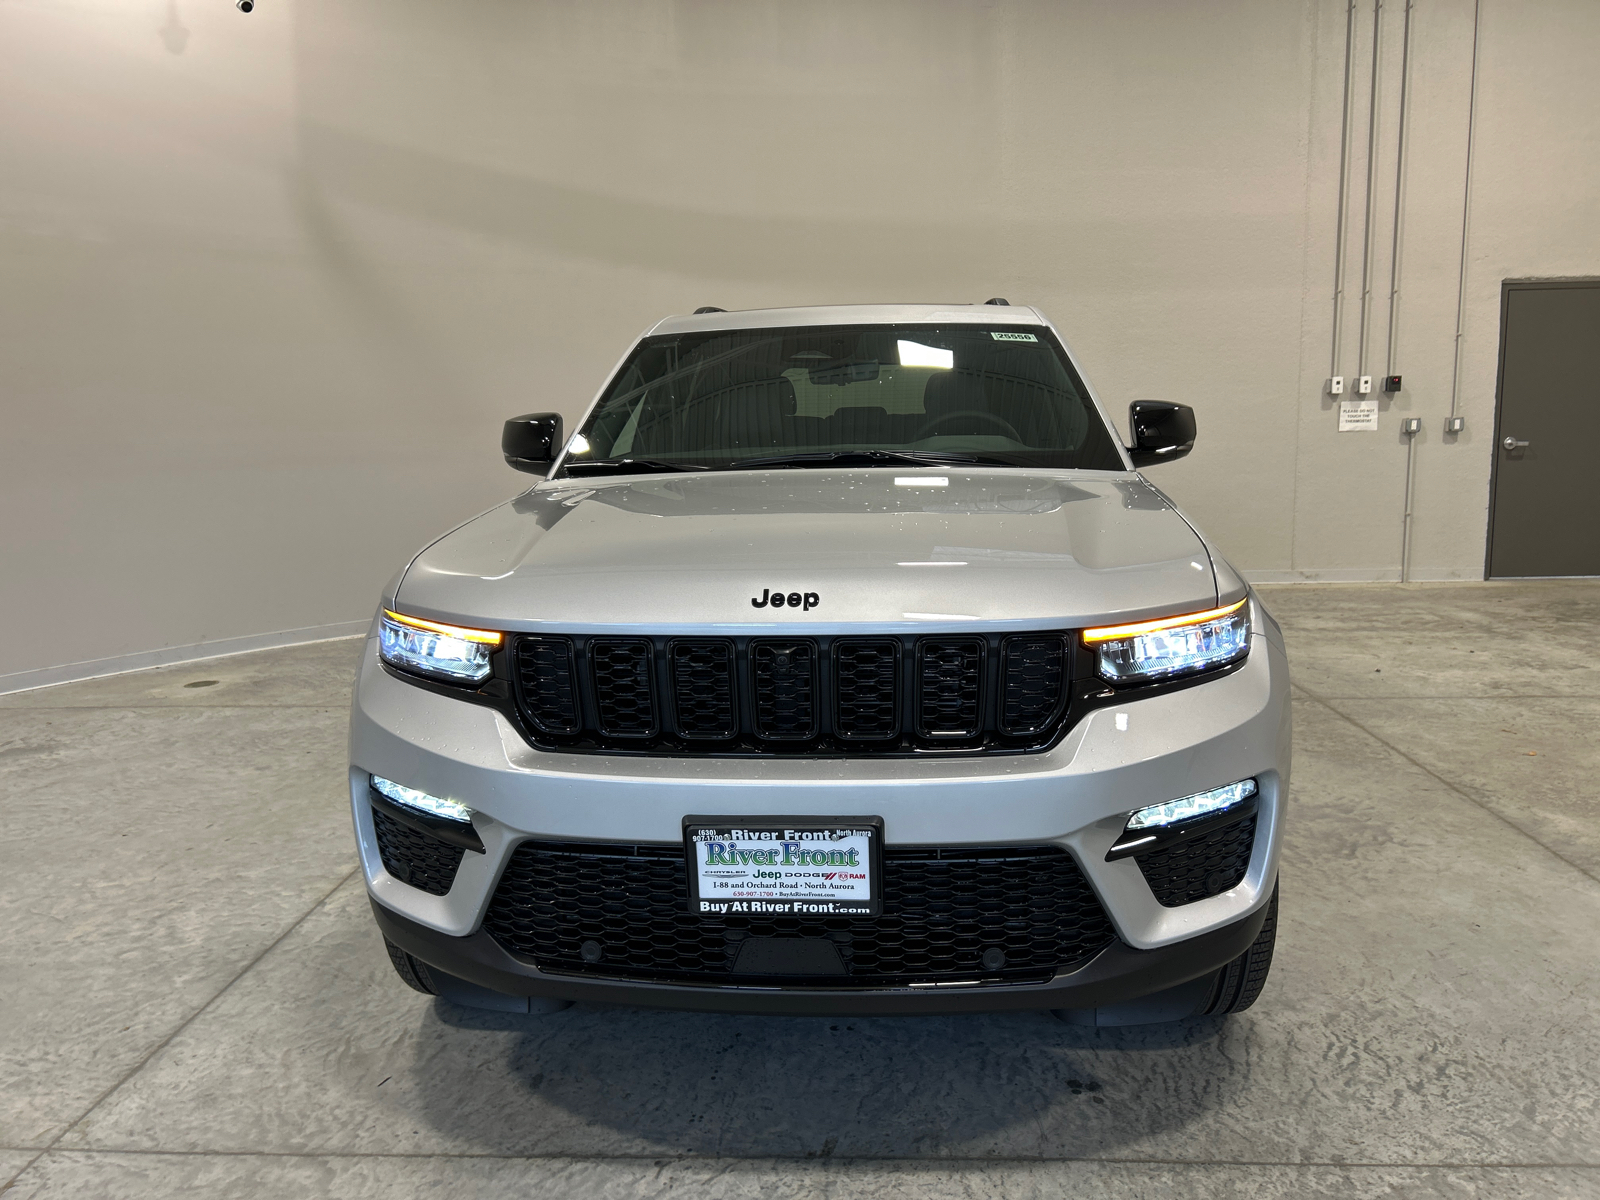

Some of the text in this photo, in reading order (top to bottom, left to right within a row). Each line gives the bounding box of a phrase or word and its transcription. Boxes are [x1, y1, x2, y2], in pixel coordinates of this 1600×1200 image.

[751, 588, 820, 612] Jeep
[731, 830, 830, 841] River Front
[852, 830, 872, 838] Aurora
[704, 841, 860, 867] River Front
[752, 870, 782, 880] Jeep
[700, 902, 728, 914] Buy
[732, 902, 748, 912] At
[751, 902, 790, 912] River
